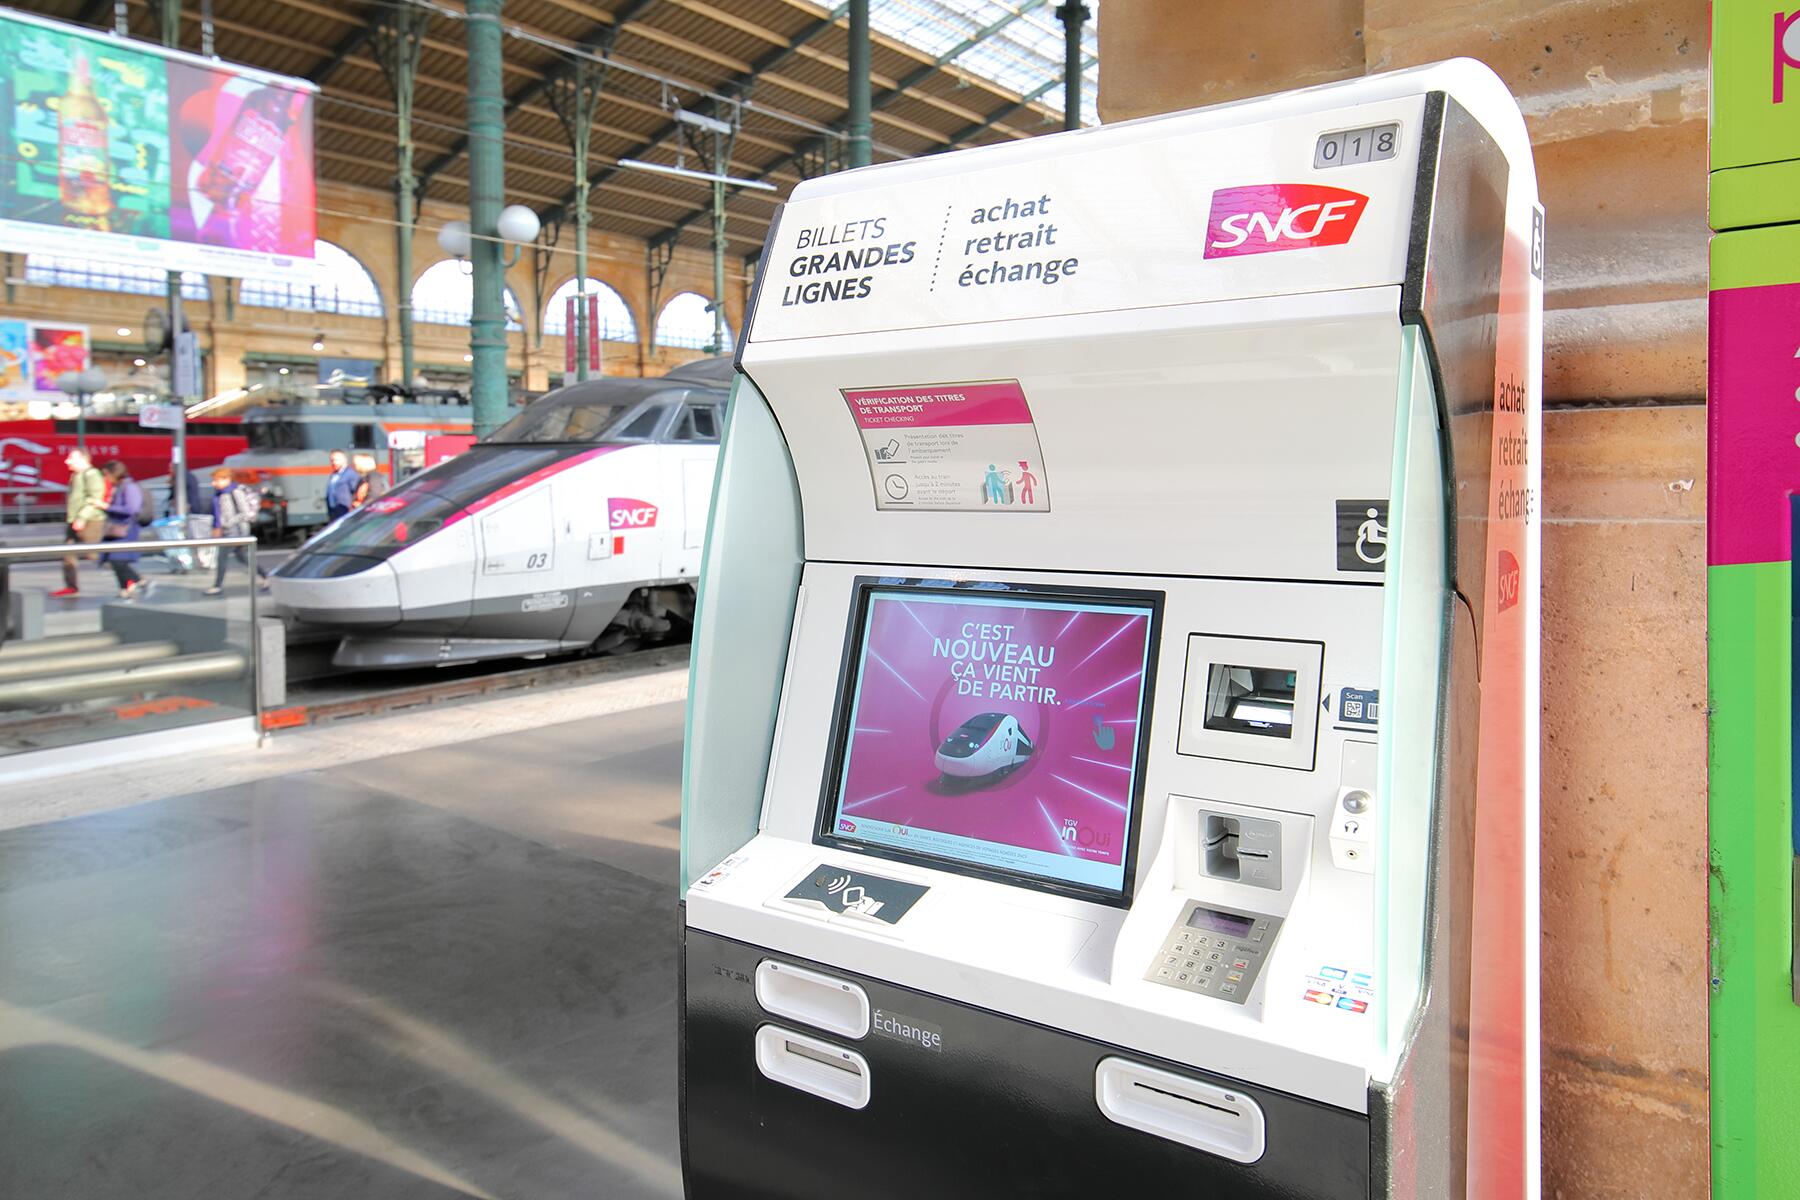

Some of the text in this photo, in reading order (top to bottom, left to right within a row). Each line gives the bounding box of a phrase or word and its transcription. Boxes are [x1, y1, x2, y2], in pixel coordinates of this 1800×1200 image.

[970, 194, 1051, 224] achat
[1211, 199, 1356, 248] SNCF
[796, 217, 886, 249] BILLETS
[964, 222, 1058, 256] retrait
[790, 241, 916, 278] GRANDES
[958, 254, 1078, 286] échange
[781, 276, 873, 307] LIGNES
[855, 393, 966, 405] VÉRIFICATION DES TITRES
[1499, 373, 1525, 414] achat
[872, 405, 924, 414] TRANSPORT
[1499, 428, 1528, 466] retrait
[610, 508, 656, 527] SNCF
[527, 553, 547, 569] 03
[962, 622, 1014, 642] C'EST
[932, 637, 1055, 668] NOUVEAU
[951, 661, 1041, 684] ÇA VIENT
[957, 679, 983, 697] DE
[989, 682, 1062, 706] PARTIR.
[1346, 692, 1364, 700] Scan
[840, 823, 855, 832] SNCF
[1064, 818, 1078, 827] TGV
[874, 1009, 941, 1047] Échange
